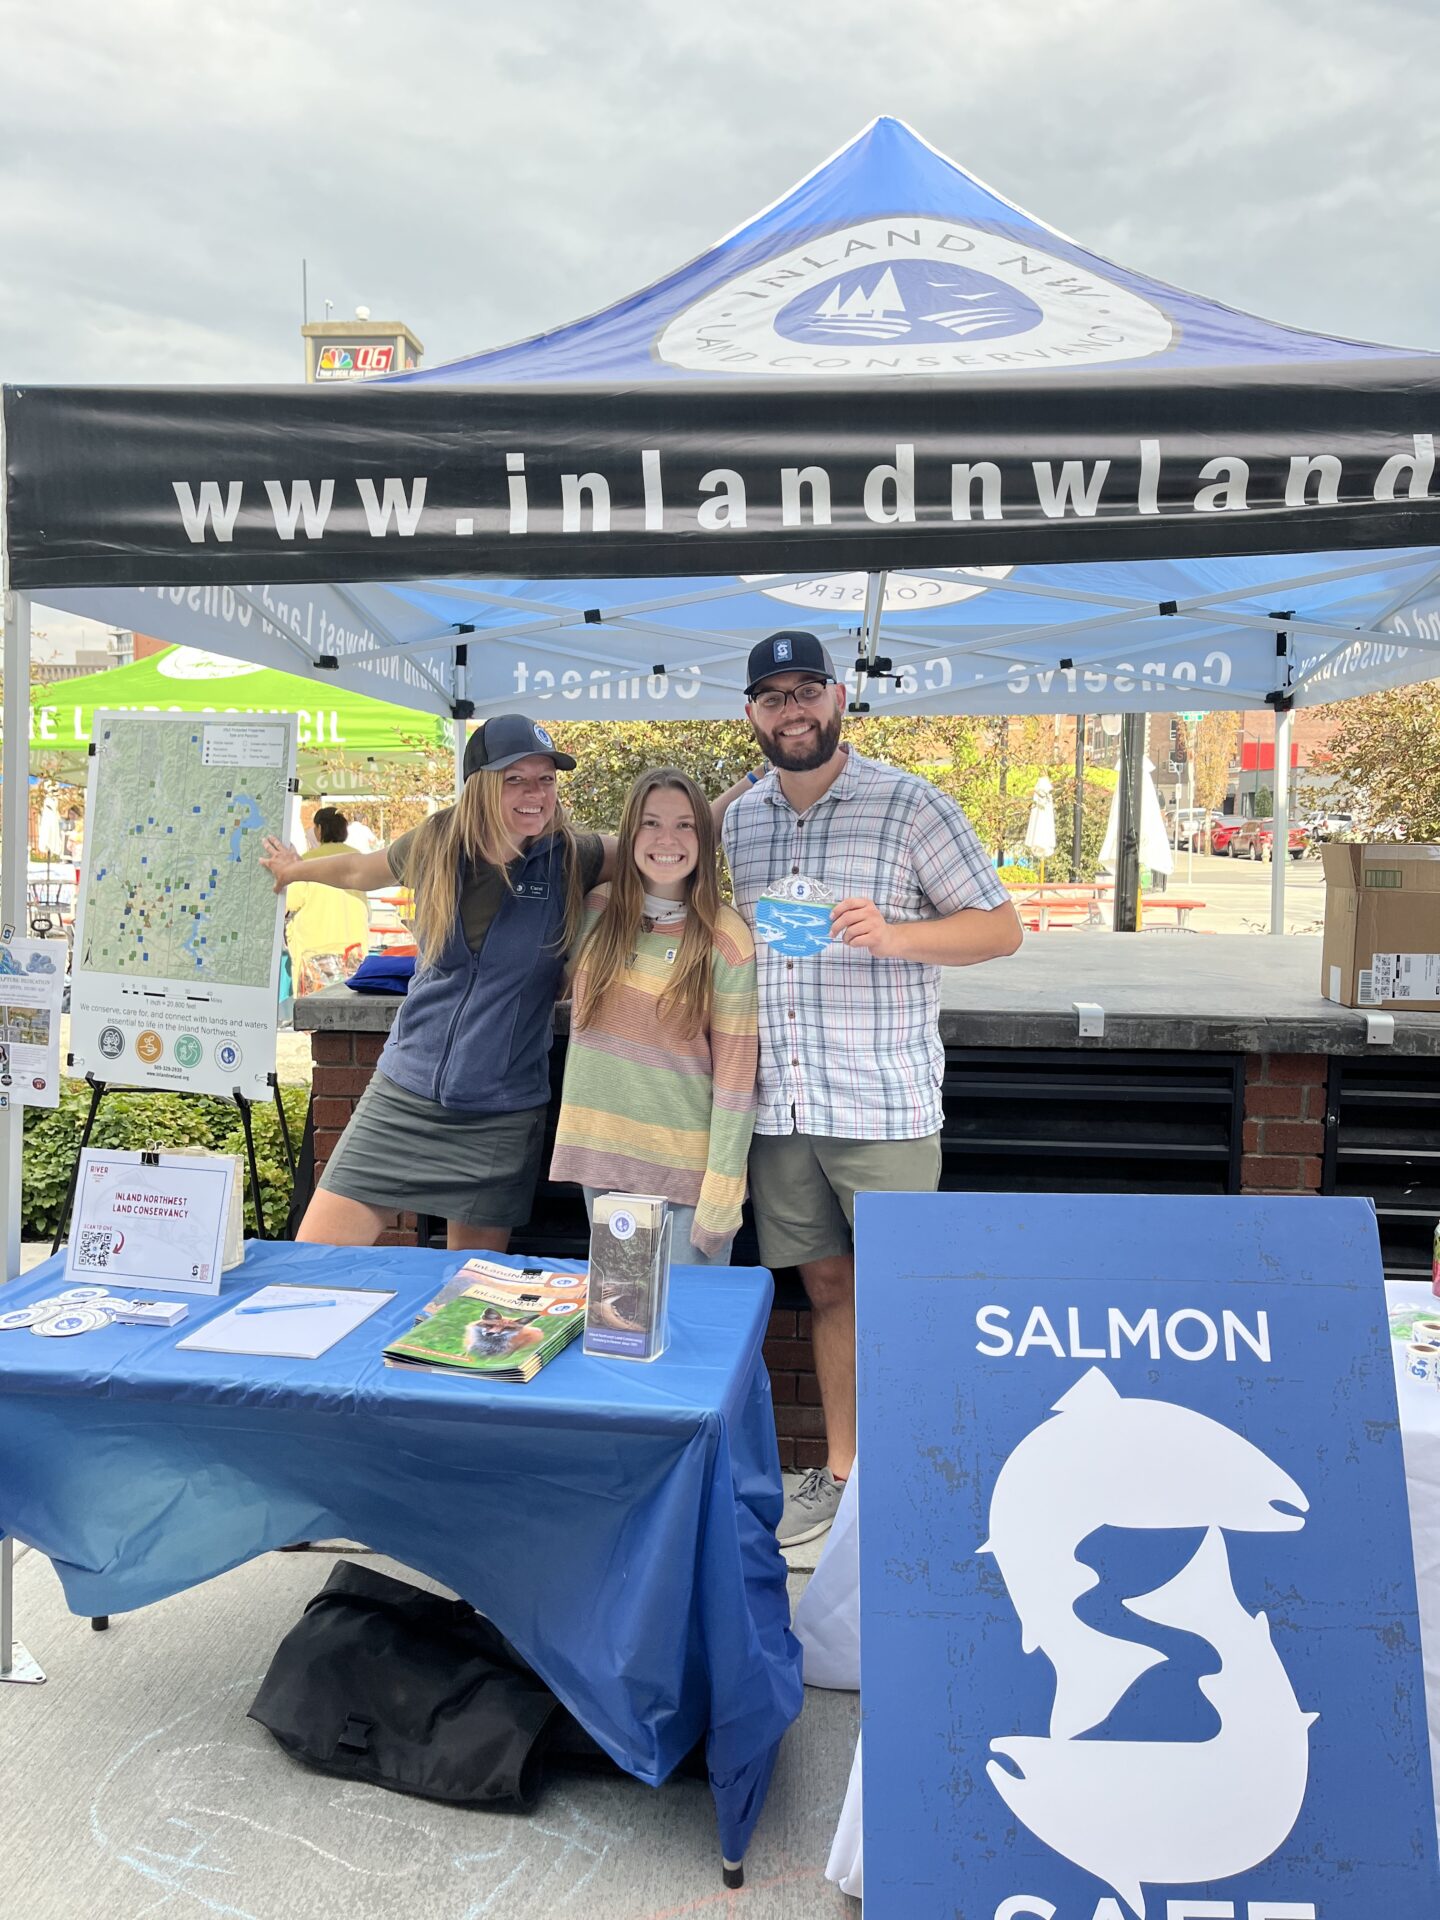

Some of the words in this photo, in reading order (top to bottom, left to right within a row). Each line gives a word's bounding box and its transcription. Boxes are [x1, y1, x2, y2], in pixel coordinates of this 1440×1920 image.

[733, 229, 976, 299] INLAND
[998, 255, 1112, 300] NW
[696, 323, 759, 362] LAND
[357, 347, 390, 369] Q6
[172, 432, 1436, 543] www.inlandnwland
[91, 1004, 122, 1014] conserve,
[150, 1010, 164, 1018] and
[164, 1012, 192, 1022] connect
[193, 1016, 208, 1024] with
[208, 1016, 228, 1026] lands
[230, 1019, 243, 1027] and
[244, 1022, 268, 1030] waters
[108, 1018, 136, 1027] essential
[146, 1020, 156, 1028] life
[166, 1023, 176, 1031] the
[178, 1024, 200, 1034] Inland
[90, 1165, 109, 1174] RIVER
[116, 1192, 142, 1202] INLAND
[144, 1194, 188, 1206] NORTHWEST
[112, 1204, 132, 1214] LAND
[134, 1206, 188, 1219] CONSERVANCY
[975, 1304, 1271, 1362] SALMON
